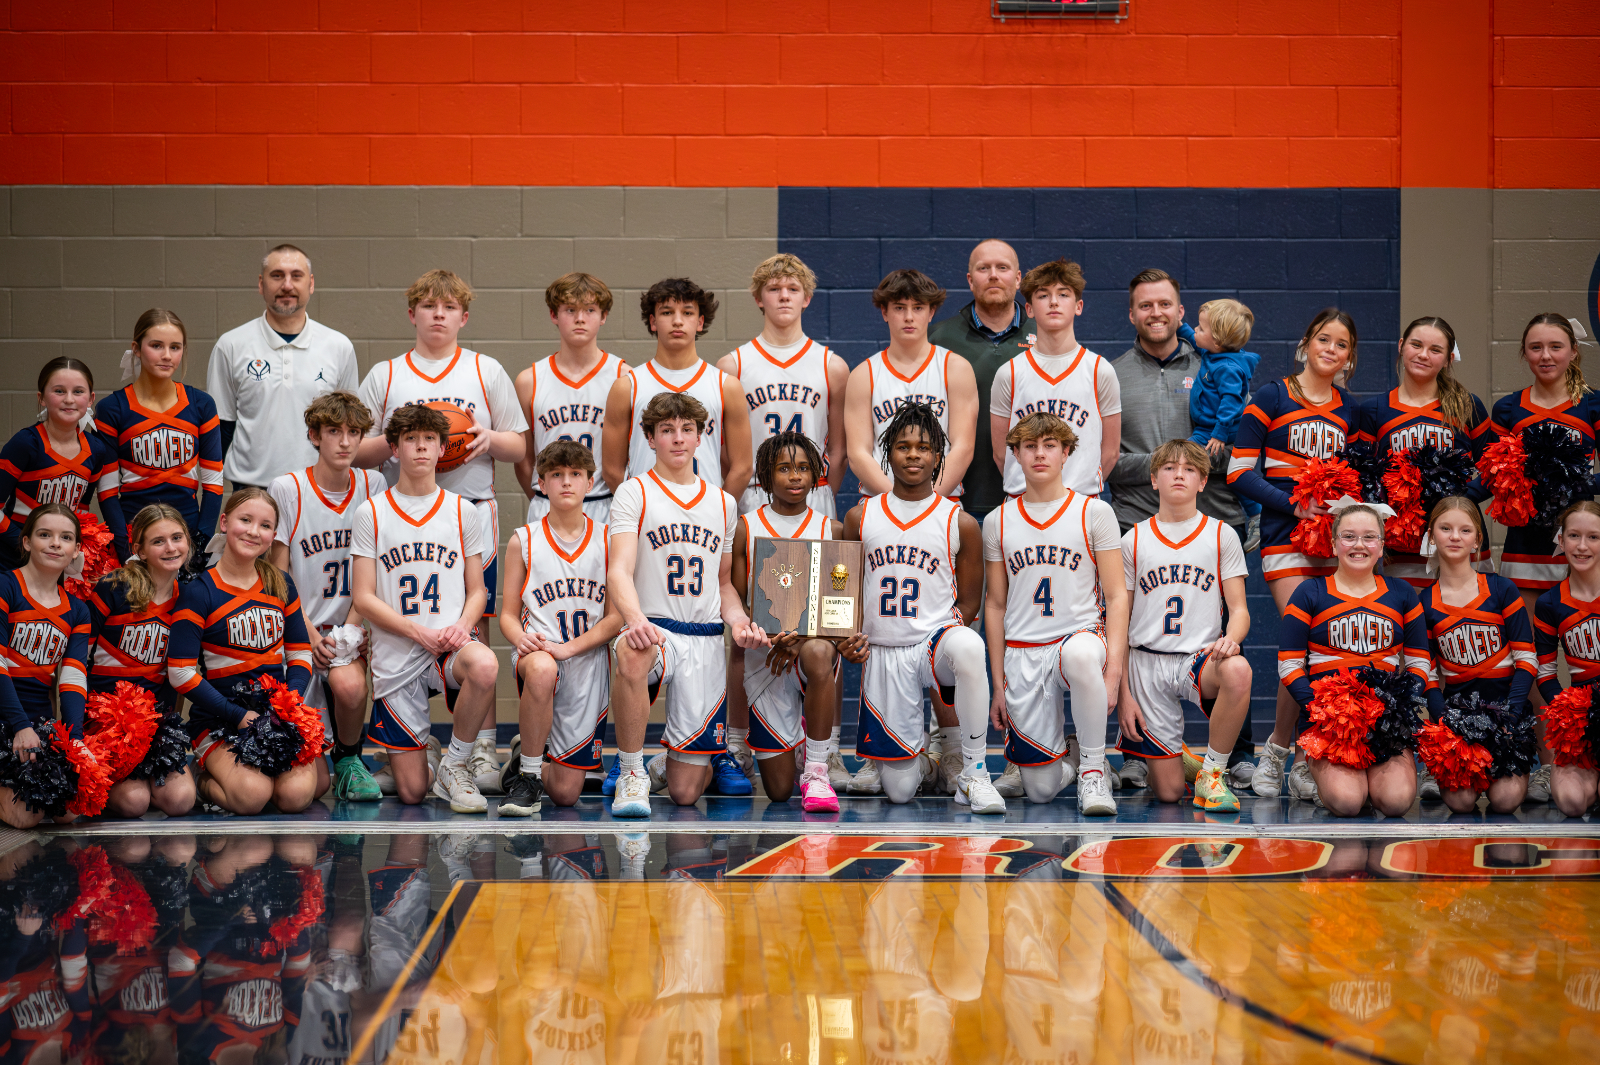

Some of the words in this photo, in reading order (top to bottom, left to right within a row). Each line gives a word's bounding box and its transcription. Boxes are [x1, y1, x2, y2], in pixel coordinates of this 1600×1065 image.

[745, 383, 822, 411] ROCKETS
[538, 404, 604, 432] ROCKET
[764, 412, 806, 441] 34
[131, 427, 195, 469] ROCKETS
[1288, 420, 1346, 460] ROCKETS
[37, 474, 89, 512] ROCKET
[380, 542, 459, 572] ROCKETS
[646, 523, 721, 554] ROCKETS
[322, 558, 352, 599] 31
[666, 554, 704, 597] 23
[867, 544, 940, 575] ROCKETS
[1008, 545, 1082, 576] ROCKETS
[1139, 564, 1215, 595] ROCKETS
[399, 572, 441, 616] 24
[531, 577, 606, 608] ROCKETS
[809, 547, 819, 631] SECTIONAL
[878, 575, 921, 619] 22
[1033, 576, 1054, 617] 4
[228, 606, 285, 649] ROCKETS
[555, 609, 589, 644] 10
[1162, 595, 1184, 636] 2
[1328, 612, 1395, 655] ROCKETS
[9, 622, 69, 665] ROCKETS
[118, 622, 170, 665] ROCKE
[1437, 622, 1502, 667] ROCKETS
